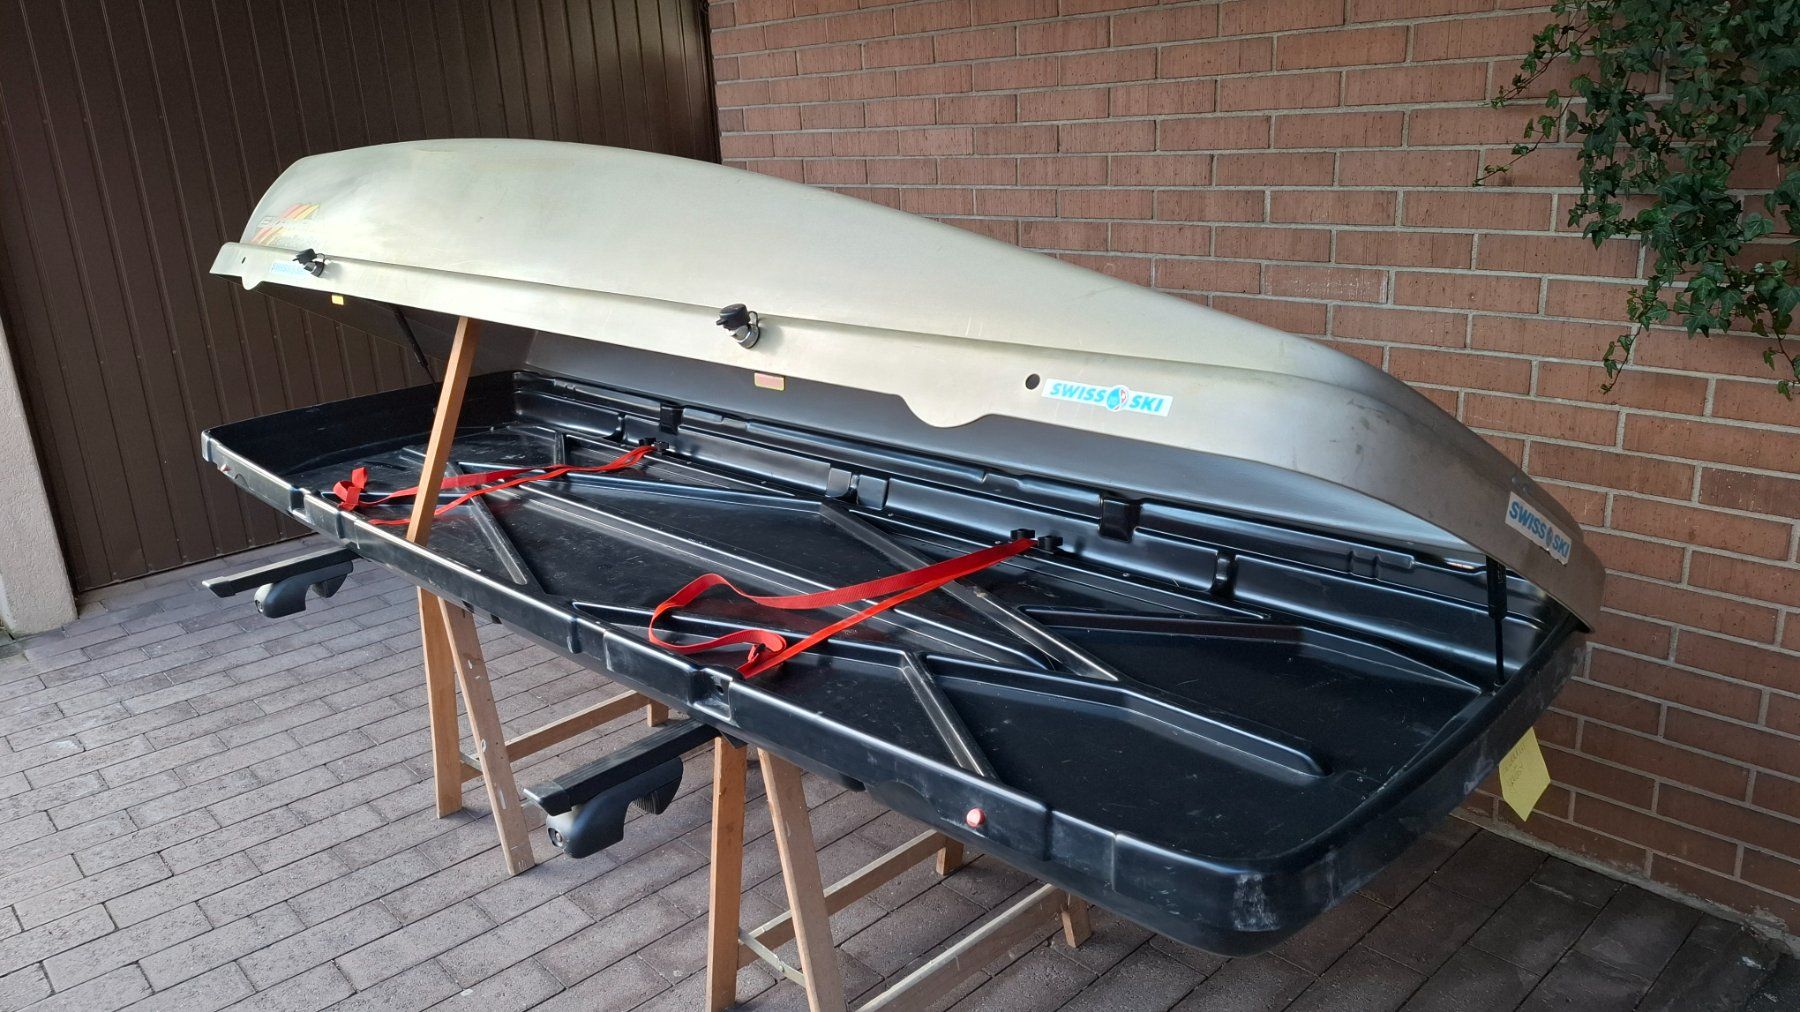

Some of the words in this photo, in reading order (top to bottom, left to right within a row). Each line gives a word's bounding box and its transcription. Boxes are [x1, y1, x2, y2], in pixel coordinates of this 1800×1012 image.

[1050, 382, 1107, 403] SWISS
[1129, 394, 1165, 412] SKI
[1509, 501, 1547, 539] SWISS
[1552, 534, 1570, 558] SKI
